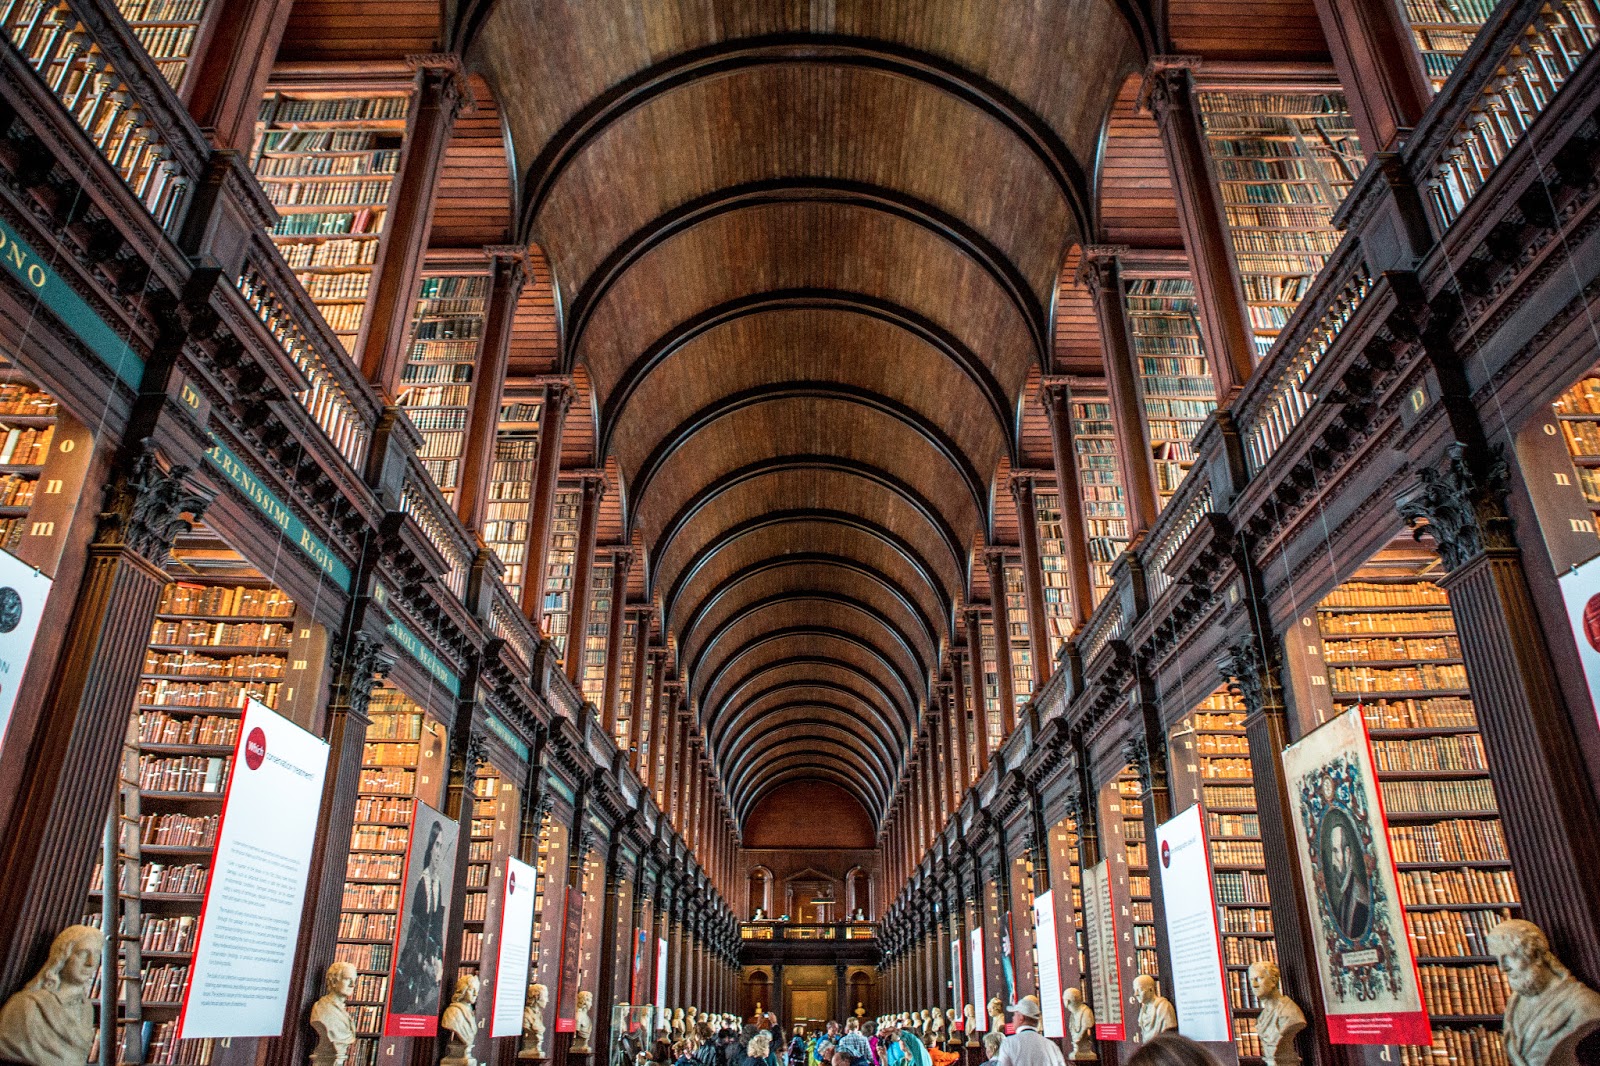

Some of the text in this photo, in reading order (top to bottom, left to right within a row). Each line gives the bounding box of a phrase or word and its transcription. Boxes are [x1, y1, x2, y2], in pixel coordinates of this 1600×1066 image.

[181, 385, 200, 409] DD
[1412, 390, 1425, 413] D
[1544, 424, 1556, 436] o
[60, 440, 74, 452] o
[1553, 473, 1571, 486] n
[44, 480, 63, 494] n
[30, 522, 54, 536] m
[1569, 519, 1594, 532] m
[299, 528, 333, 573] REGIS
[1303, 617, 1312, 626] o
[300, 629, 310, 638] n
[1308, 645, 1318, 654] n
[293, 660, 307, 670] m
[1312, 676, 1326, 686] m
[248, 740, 264, 757] Which
[499, 821, 506, 830] k
[1122, 906, 1128, 916] h
[1124, 932, 1130, 941] g
[483, 978, 489, 986] e
[1129, 996, 1135, 1004] e
[478, 1018, 485, 1028] d
[386, 1044, 395, 1056] d
[1380, 1044, 1391, 1062] d
